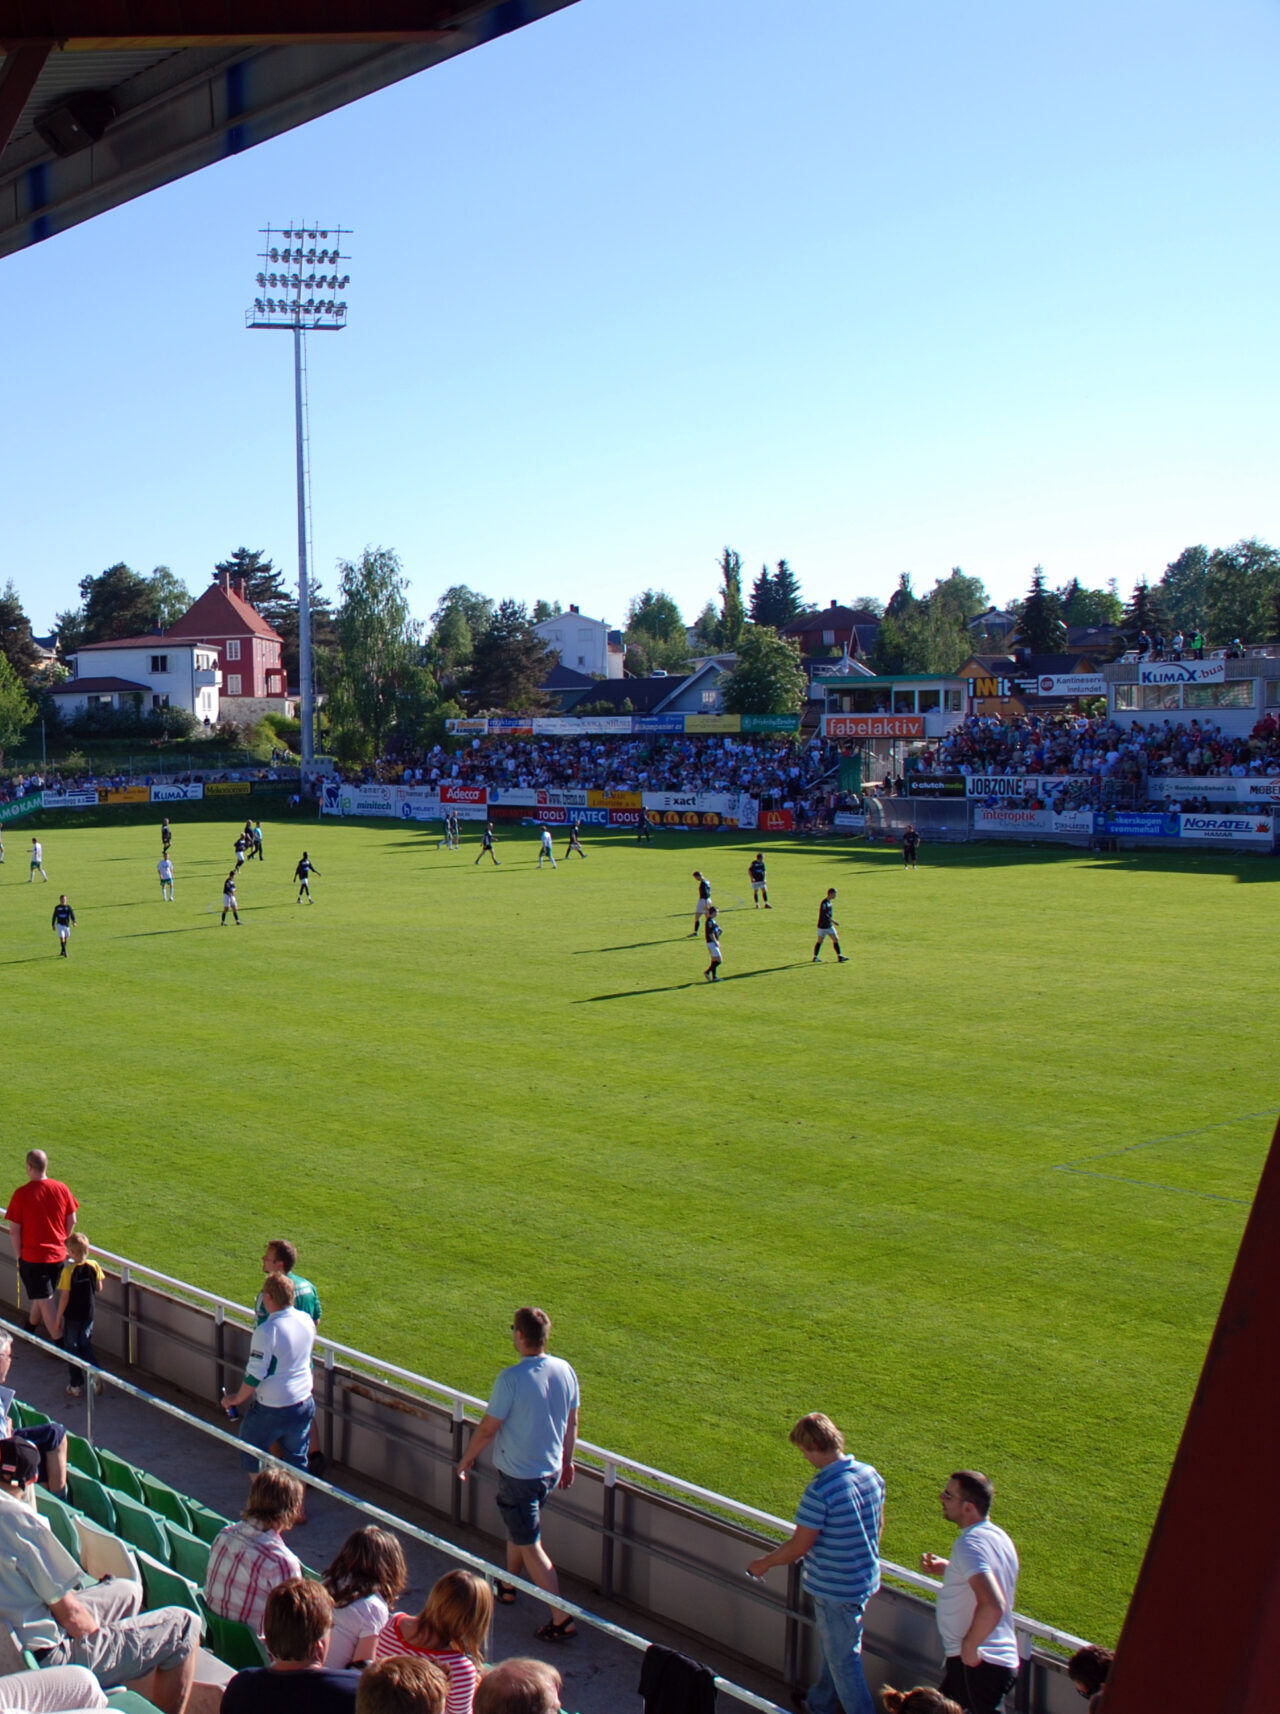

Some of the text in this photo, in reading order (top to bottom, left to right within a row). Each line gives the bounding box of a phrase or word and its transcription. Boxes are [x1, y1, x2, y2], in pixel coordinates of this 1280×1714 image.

[829, 718, 919, 735] fabelaktiv
[968, 778, 1022, 795] JOBZONE
[153, 789, 190, 800] KLIMAX
[446, 789, 480, 800] Adecco
[538, 810, 564, 820] TOOLS
[570, 811, 606, 823] HATEC
[612, 812, 640, 822] TOOLS
[1108, 815, 1162, 826] nkerskogen
[1183, 818, 1253, 830] NORATEL
